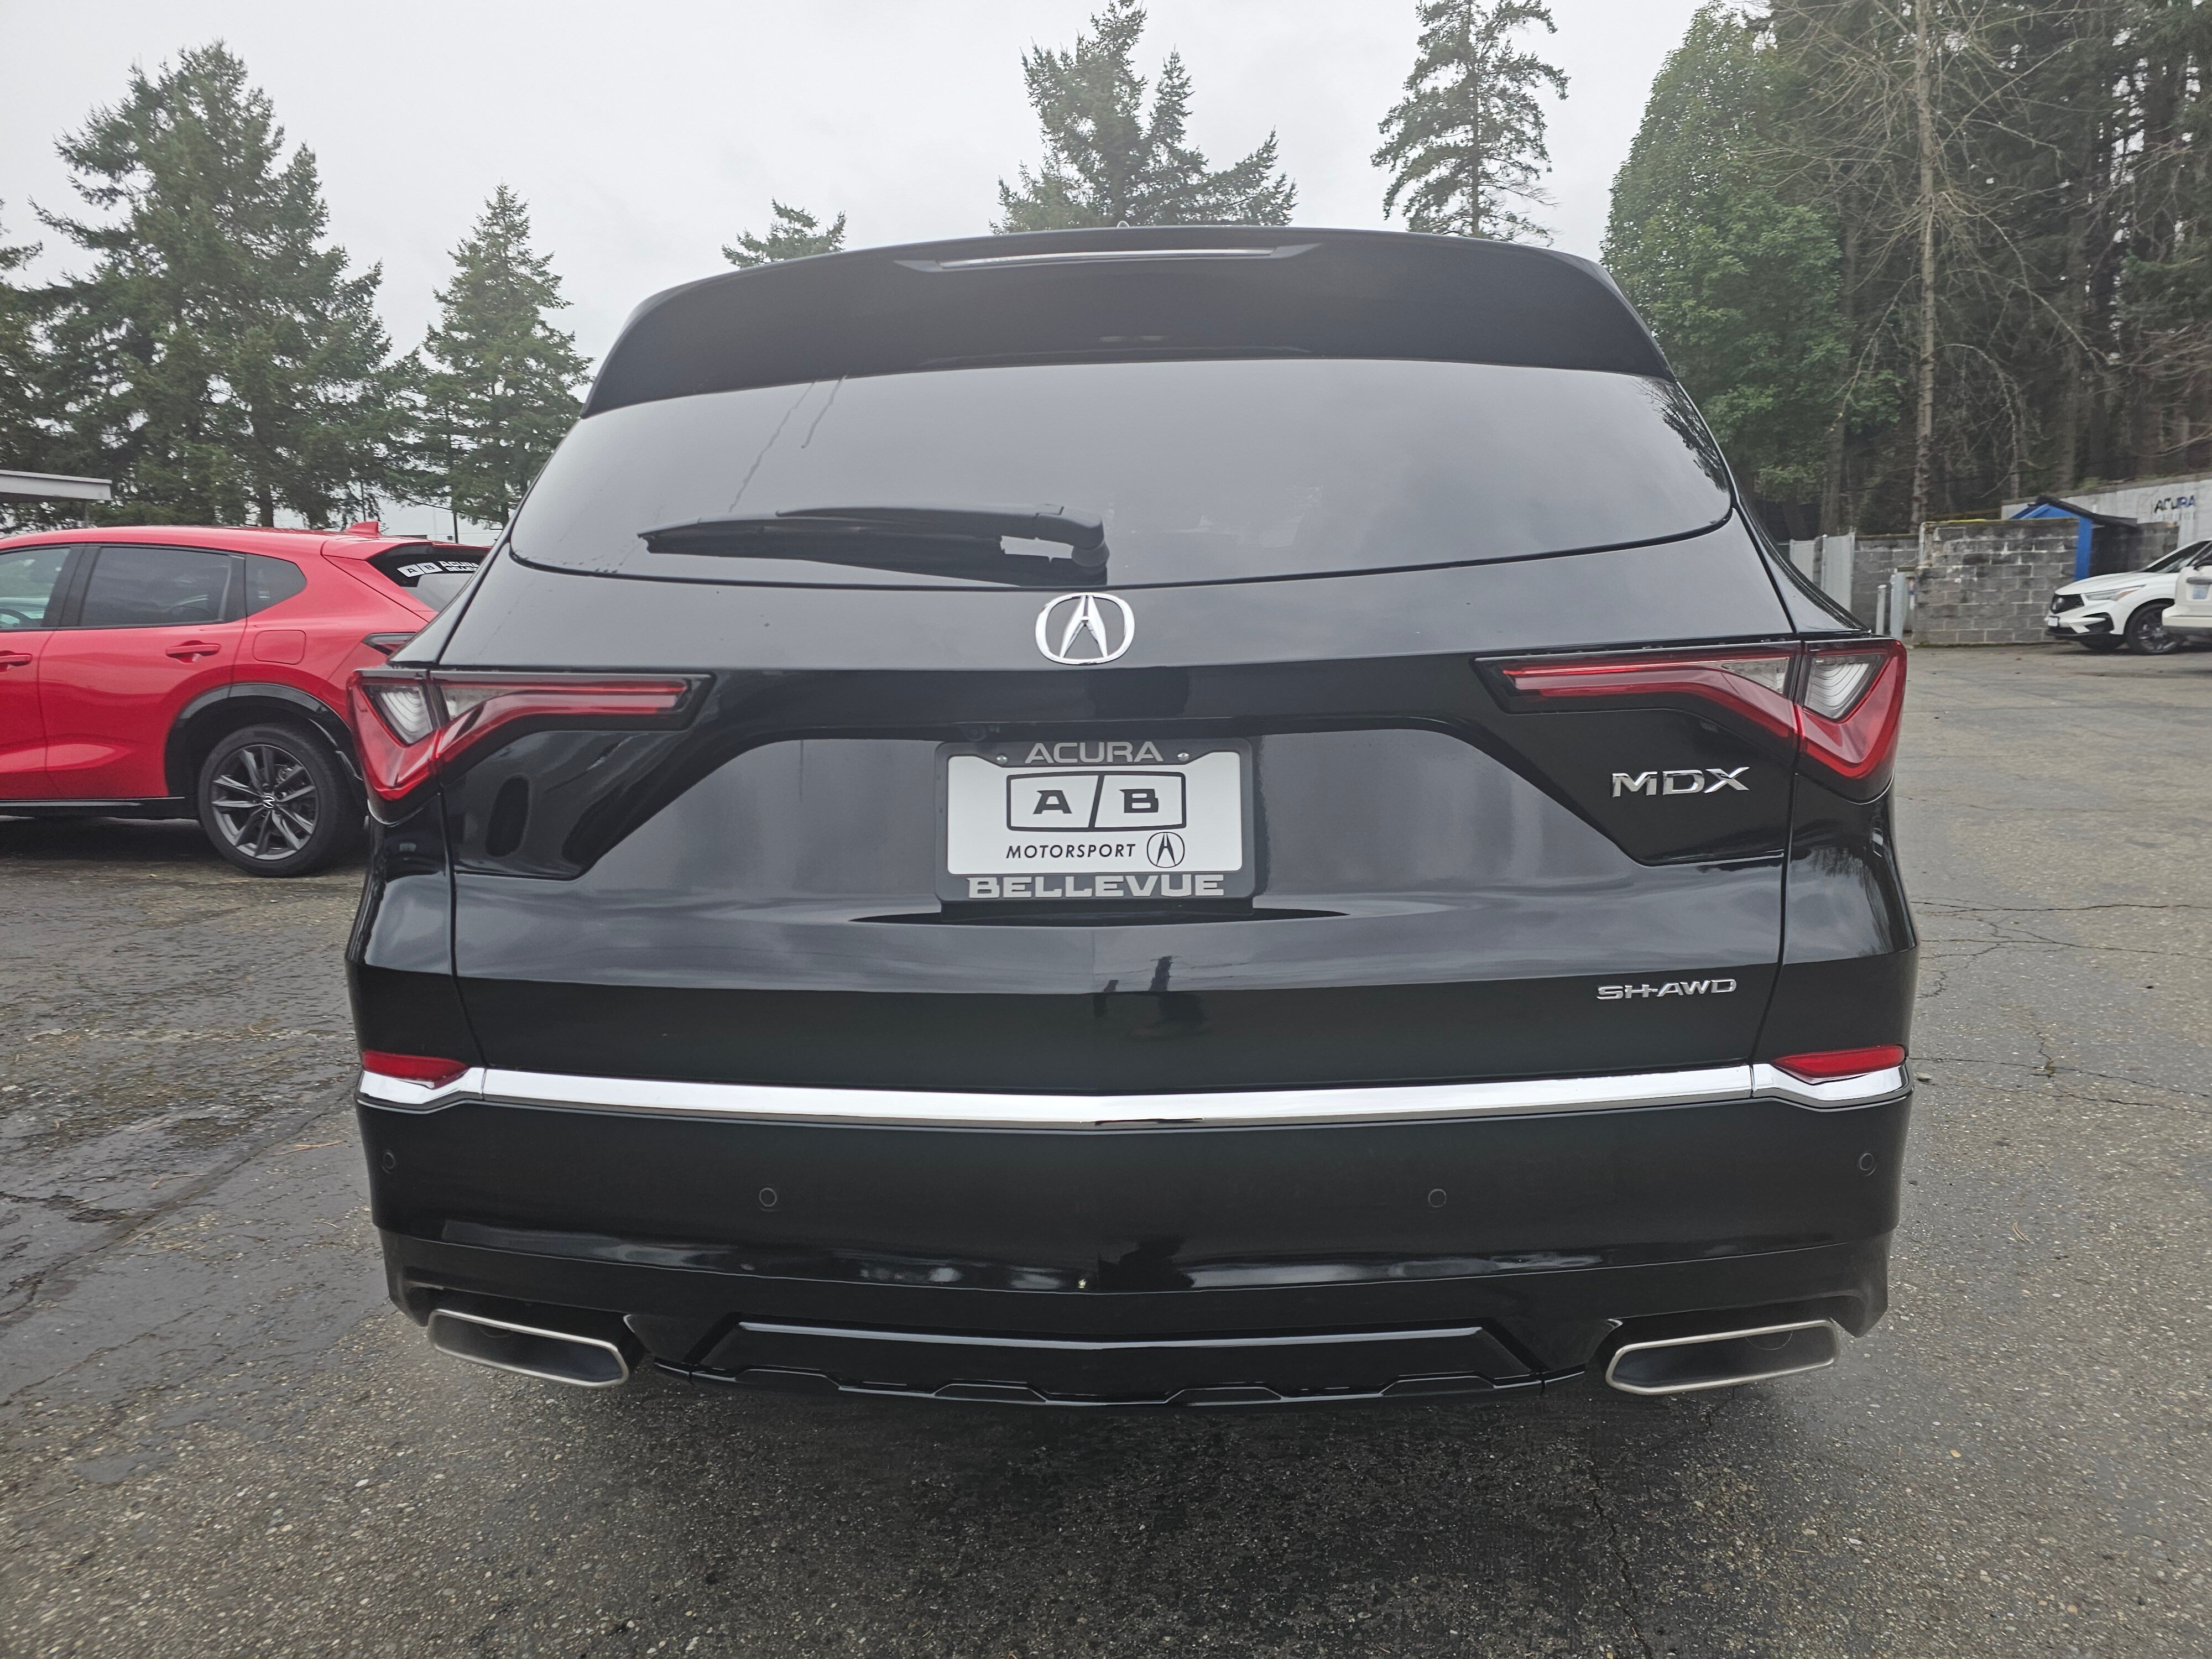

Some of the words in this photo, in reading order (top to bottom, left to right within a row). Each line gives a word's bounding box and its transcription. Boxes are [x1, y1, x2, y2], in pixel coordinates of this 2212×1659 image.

[1024, 741, 1164, 764] ACURA
[1612, 767, 1750, 797] MDX
[1032, 790, 1072, 815] A
[1119, 789, 1159, 813] B
[1006, 843, 1136, 859] MOTORSPORT
[966, 875, 1224, 899] BELLEVUE
[1597, 979, 1737, 1000] SH-AWD
